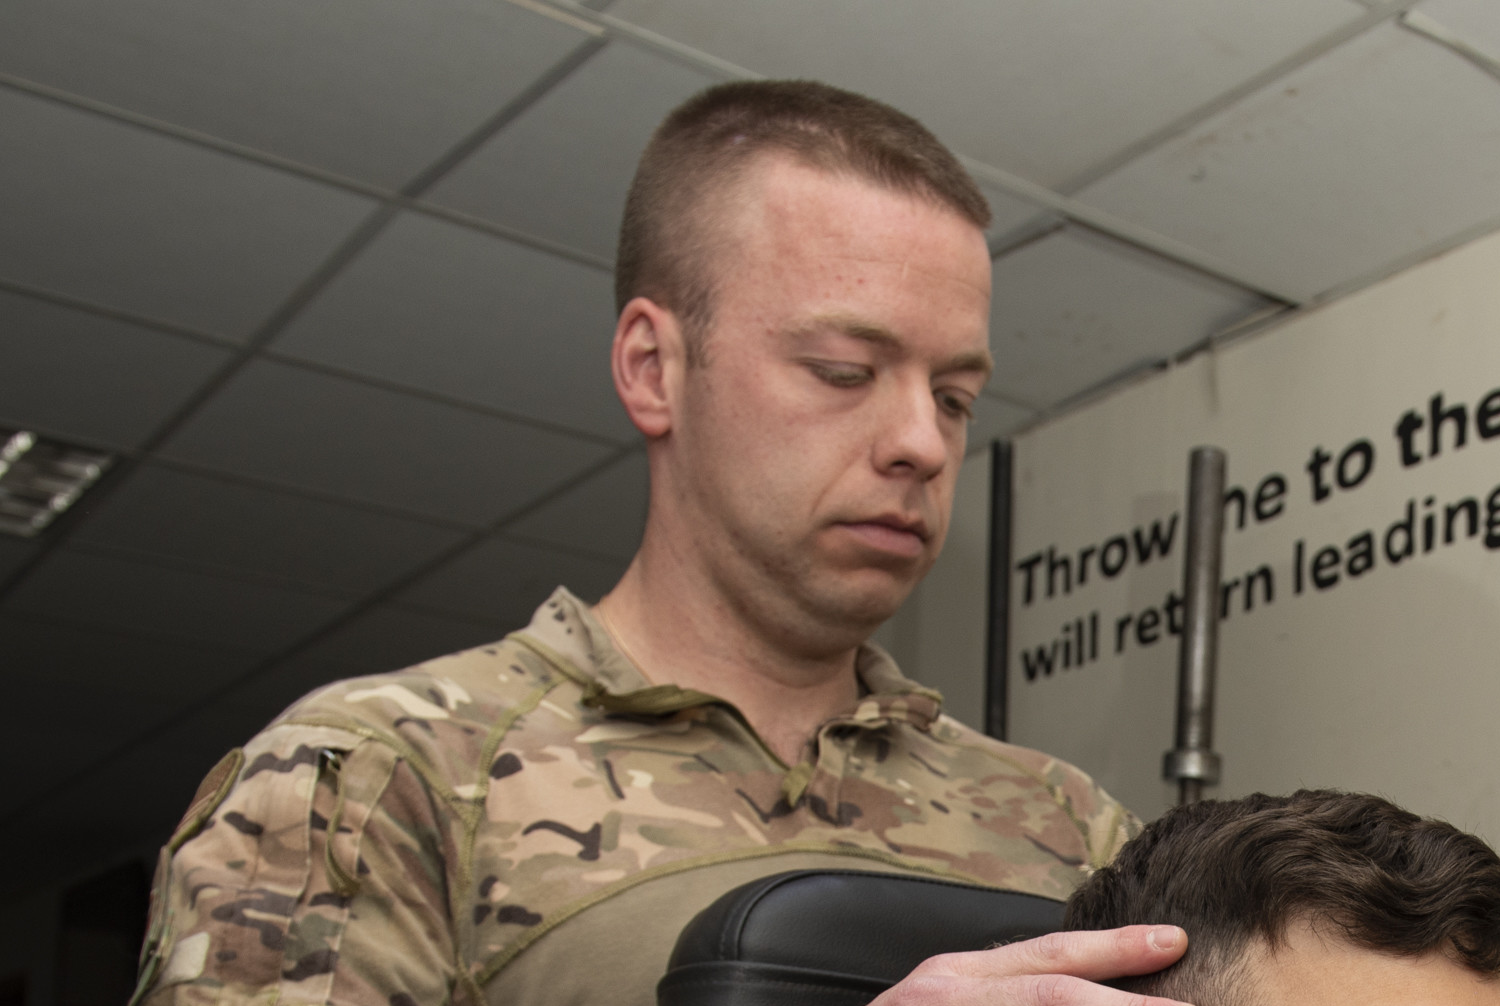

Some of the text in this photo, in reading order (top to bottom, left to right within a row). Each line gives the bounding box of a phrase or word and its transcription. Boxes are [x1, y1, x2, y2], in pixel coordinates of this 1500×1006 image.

[1017, 513, 1180, 607] Throw
[1306, 438, 1376, 503] to
[1020, 611, 1100, 684] will
[1115, 564, 1275, 655] retrn
